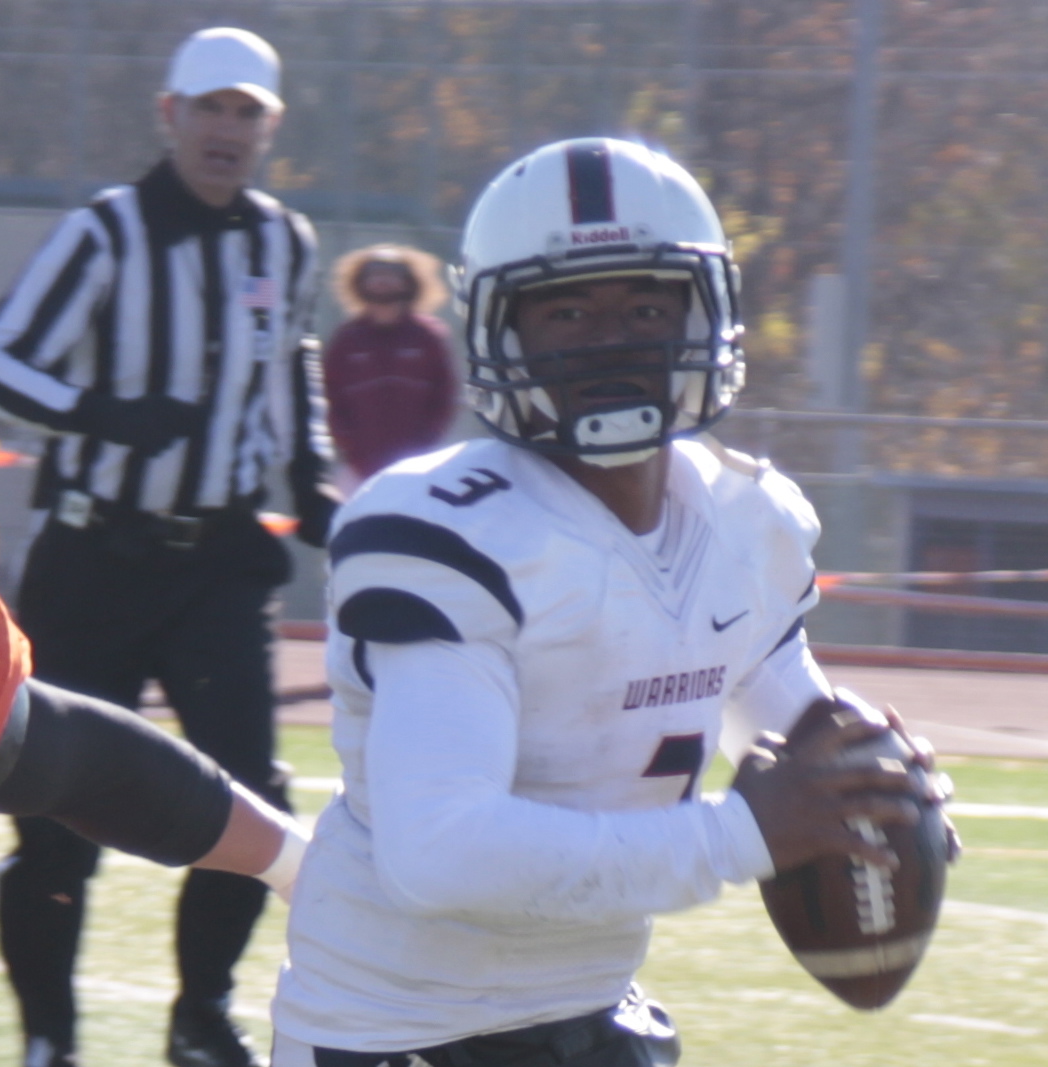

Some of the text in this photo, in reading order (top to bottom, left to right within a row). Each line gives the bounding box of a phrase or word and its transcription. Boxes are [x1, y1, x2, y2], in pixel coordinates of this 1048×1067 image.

[571, 226, 630, 244] Riddell
[427, 467, 512, 507] 3
[621, 665, 726, 710] WARRIORS
